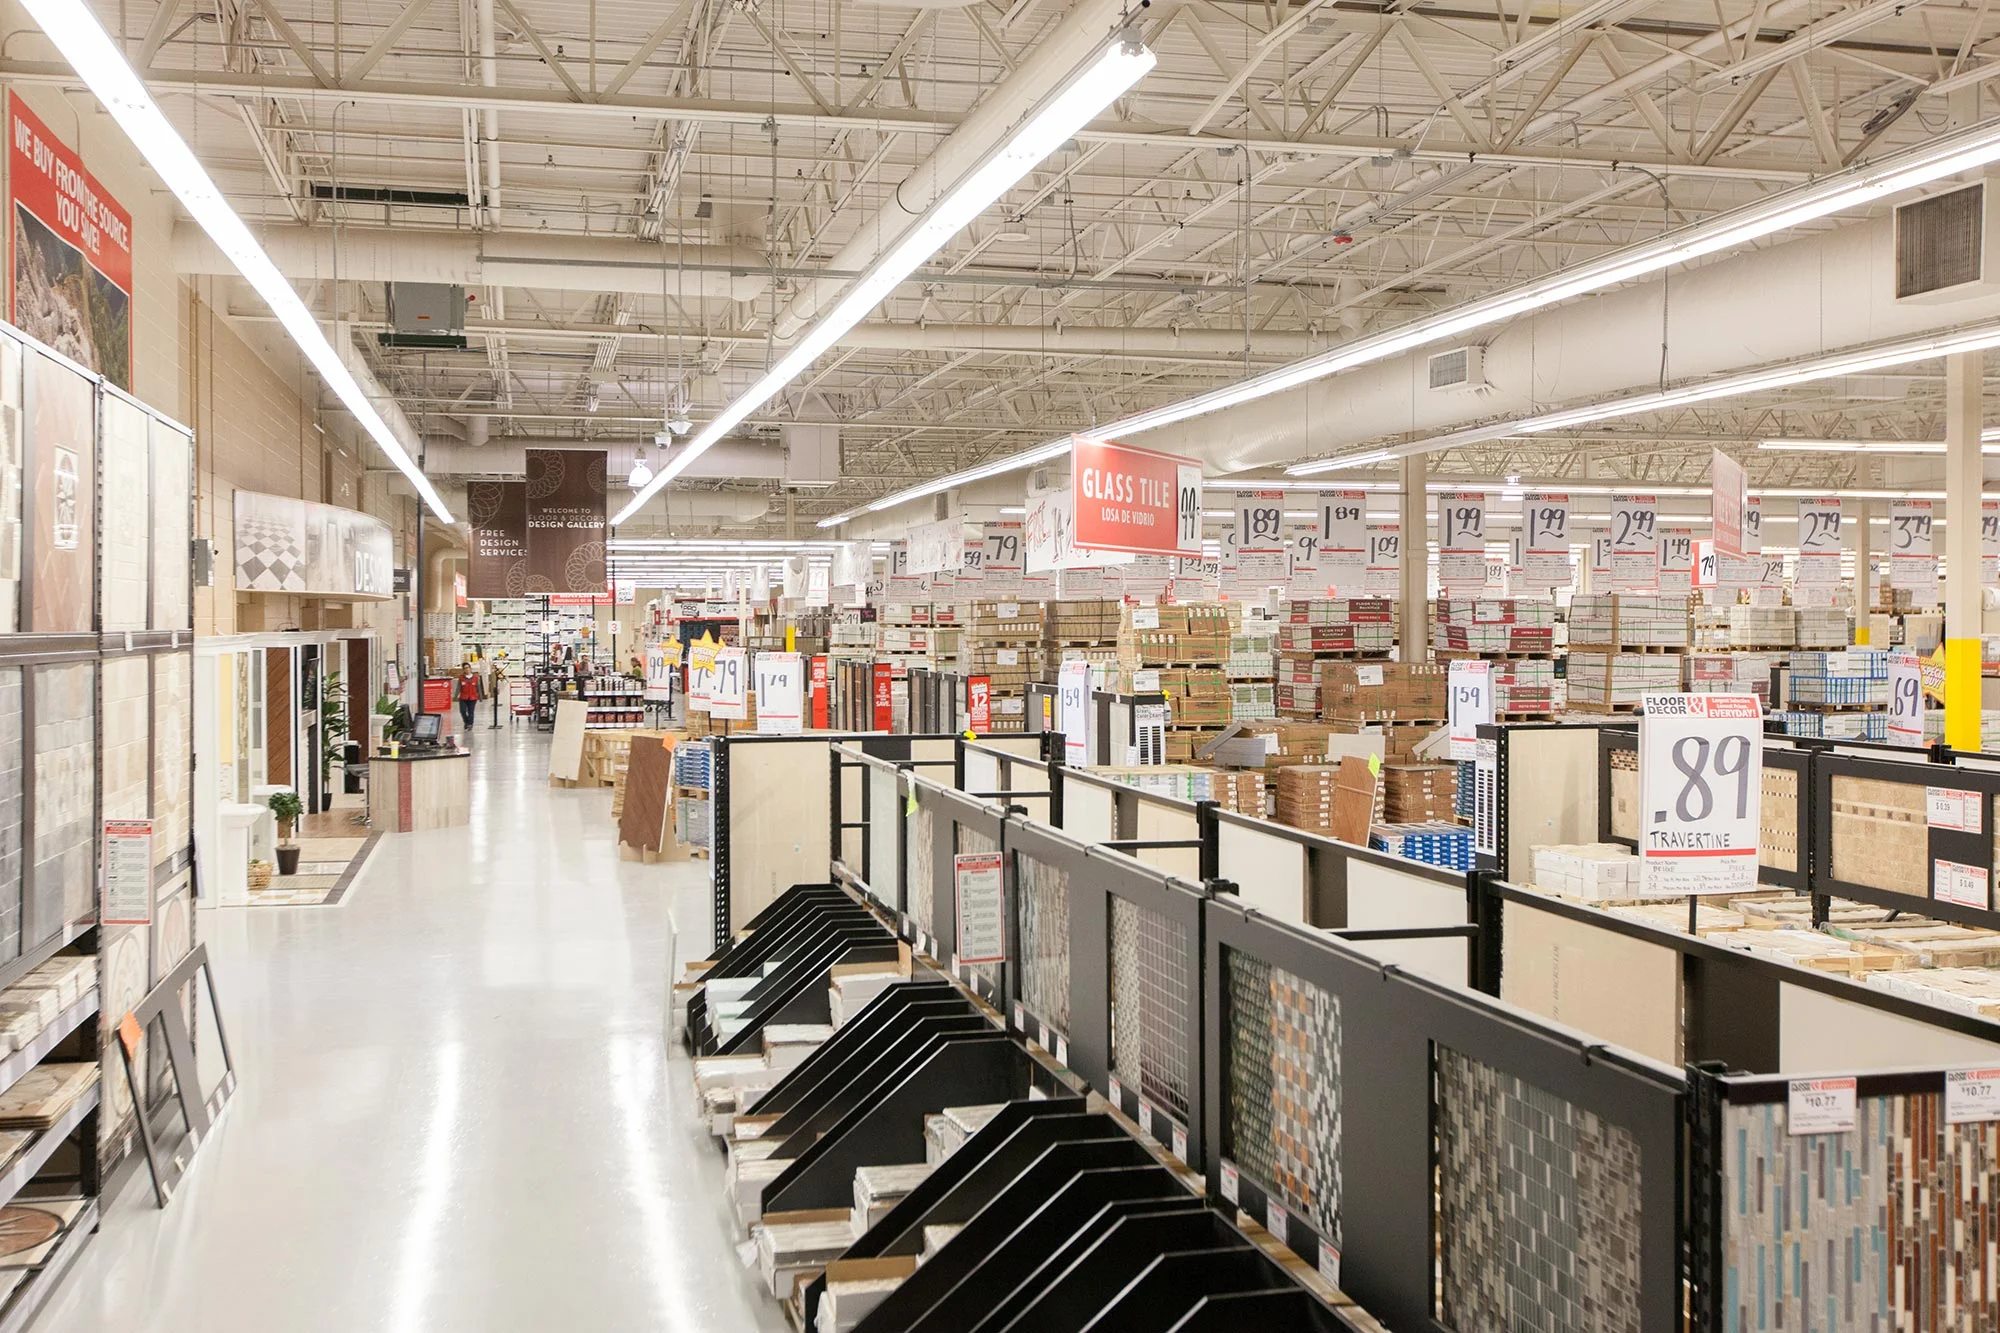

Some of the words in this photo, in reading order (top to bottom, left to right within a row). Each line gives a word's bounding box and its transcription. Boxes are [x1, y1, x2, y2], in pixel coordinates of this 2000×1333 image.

[14, 115, 32, 160] WE
[34, 135, 54, 179] BUY
[56, 157, 84, 207] FROM
[84, 186, 98, 224] THE
[100, 202, 130, 253] SOURCE.
[56, 191, 79, 232] YOU
[81, 212, 100, 256] SAVE!
[1082, 468, 1133, 503] GLASS
[1140, 477, 1170, 508] TILE
[1102, 507, 1120, 522] LOSA
[1122, 512, 1131, 523] DE
[1132, 511, 1155, 526] VIDRIO
[567, 521, 605, 529] GALLERY
[480, 539, 519, 547] DESIGN
[986, 536, 1017, 562] .79
[611, 623, 617, 632] 3
[1922, 666, 1945, 680] SPECIA
[971, 693, 988, 708] 12
[1646, 697, 1686, 706] FLOOR
[1889, 677, 1919, 717] .69
[1648, 706, 1687, 714] DECOR
[1709, 709, 1757, 717] EVERYDAY!
[1655, 735, 1750, 823] .89
[1650, 831, 1730, 848] TRAVERTINE
